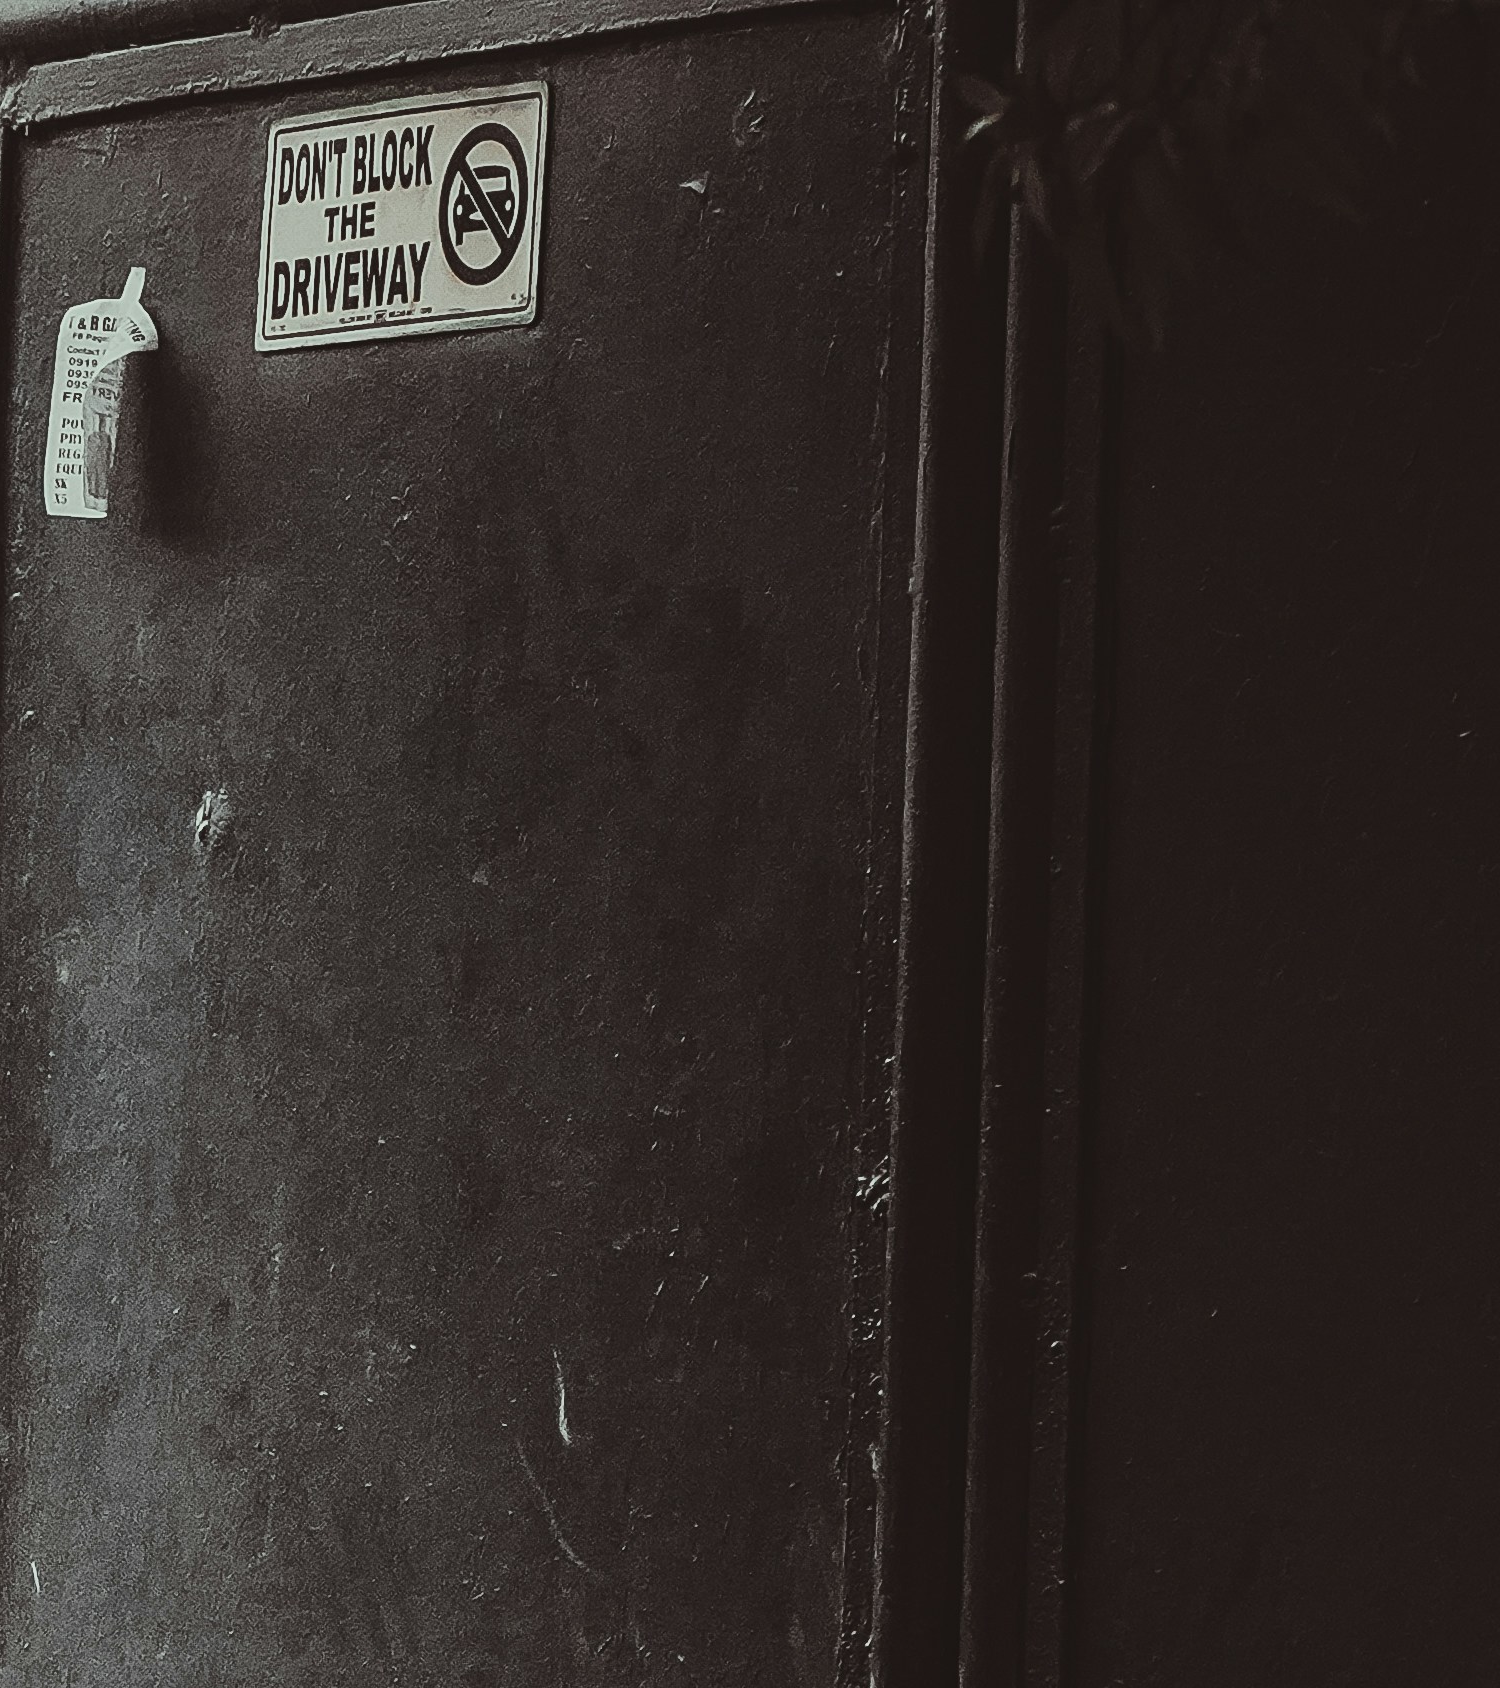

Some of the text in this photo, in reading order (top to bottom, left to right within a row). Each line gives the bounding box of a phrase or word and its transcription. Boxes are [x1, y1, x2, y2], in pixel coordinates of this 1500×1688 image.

[278, 125, 435, 206] DON'T BLOCK
[324, 201, 377, 243] THE
[270, 240, 431, 321] DRIVEWAY
